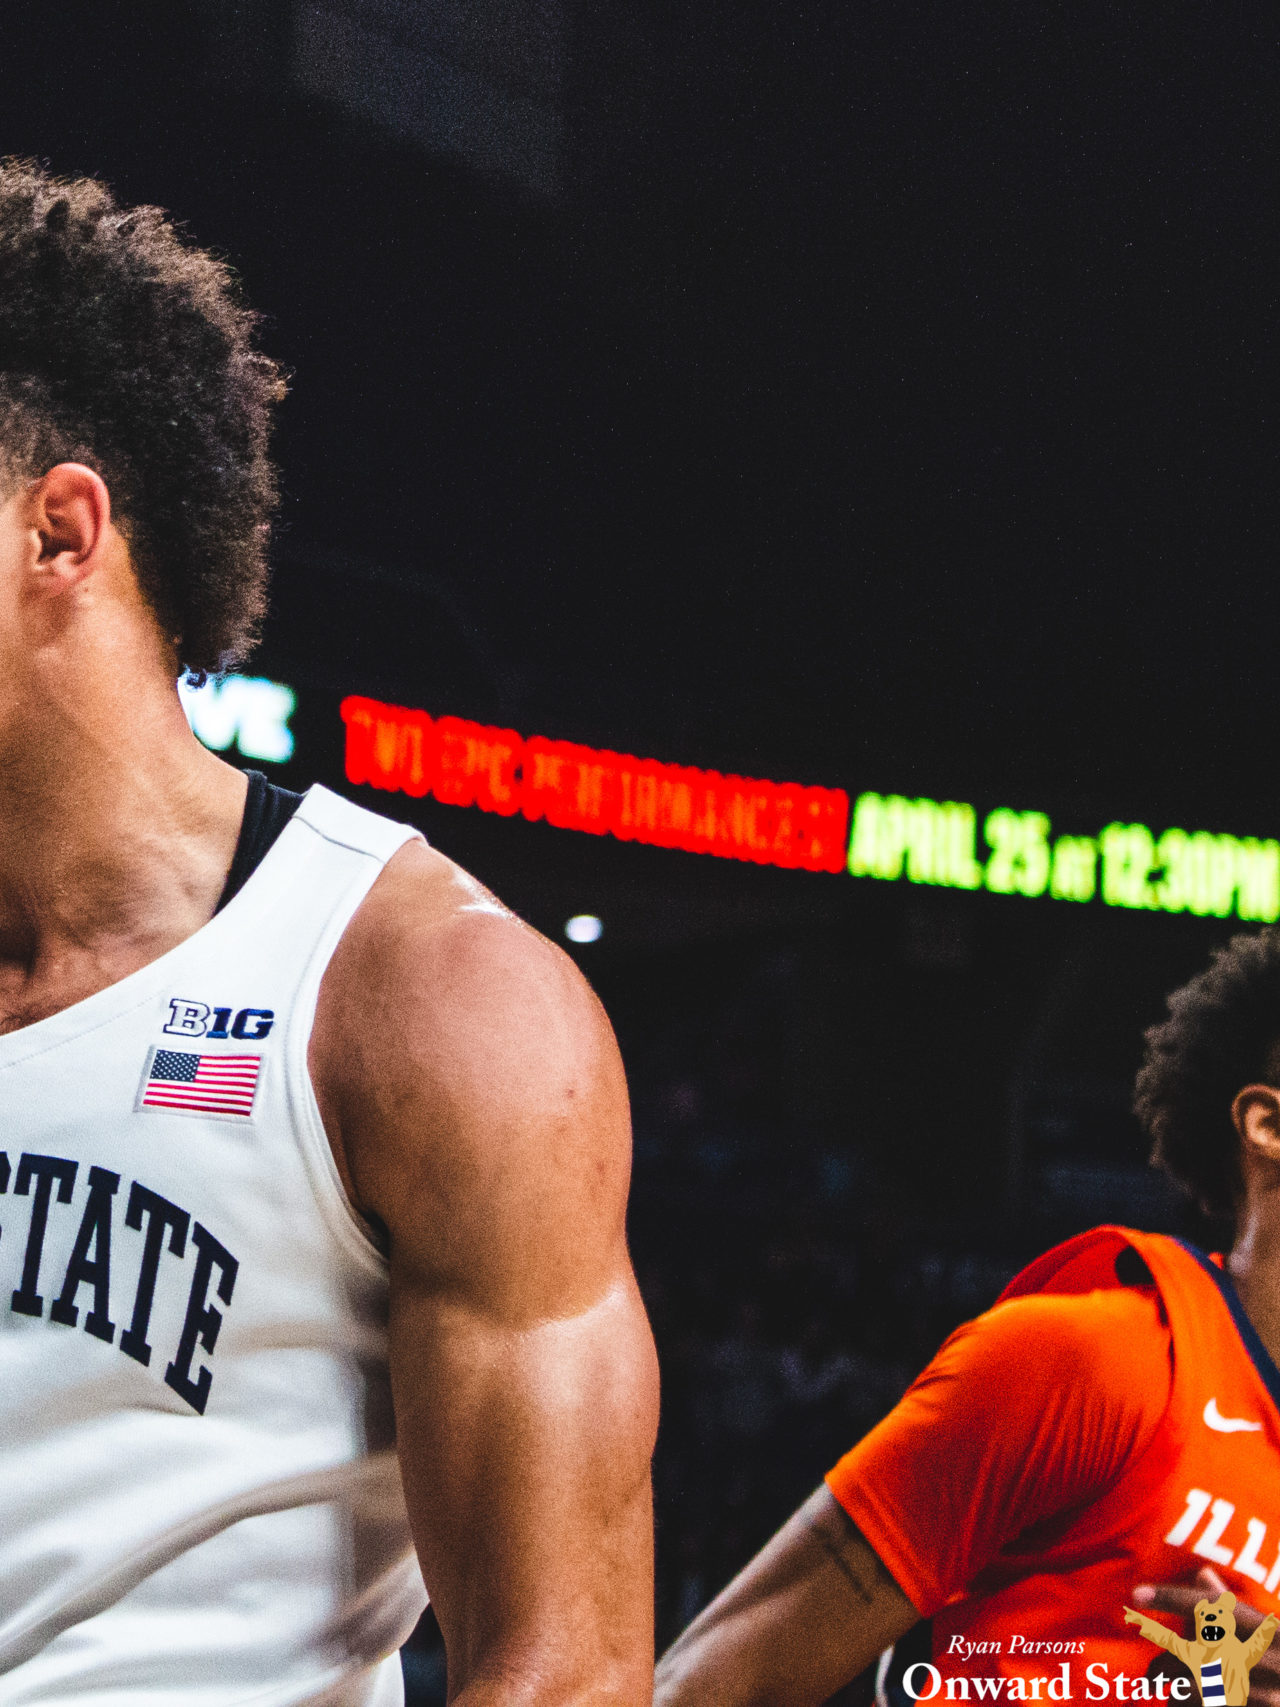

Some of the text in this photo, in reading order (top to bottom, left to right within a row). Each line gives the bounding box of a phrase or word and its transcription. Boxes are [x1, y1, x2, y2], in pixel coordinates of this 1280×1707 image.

[848, 791, 982, 890] APRIL
[983, 807, 1052, 898] 25
[1099, 821, 1280, 924] 12:30PM
